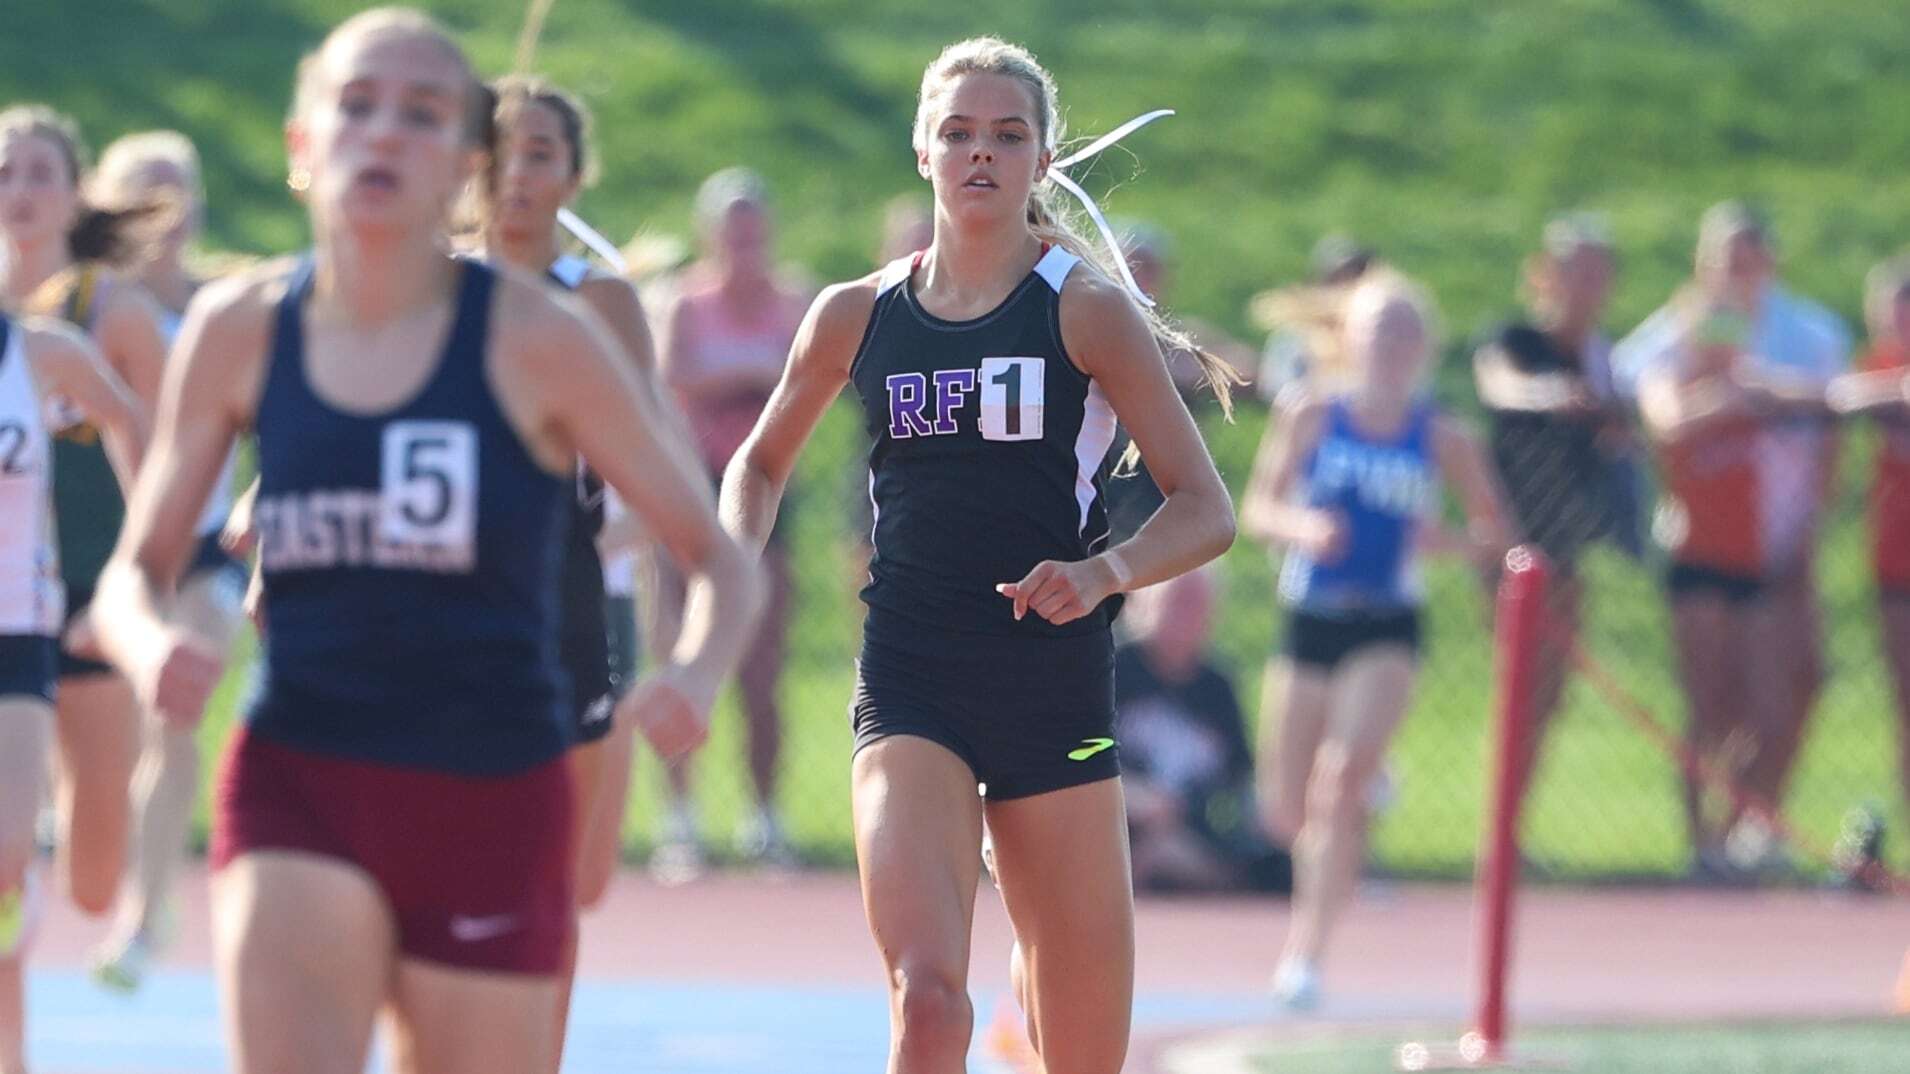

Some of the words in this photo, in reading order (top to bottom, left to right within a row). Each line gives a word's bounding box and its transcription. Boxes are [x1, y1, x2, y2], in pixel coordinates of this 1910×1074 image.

[886, 369, 983, 438] RF
[992, 363, 1022, 435] 1
[402, 440, 452, 527] 5
